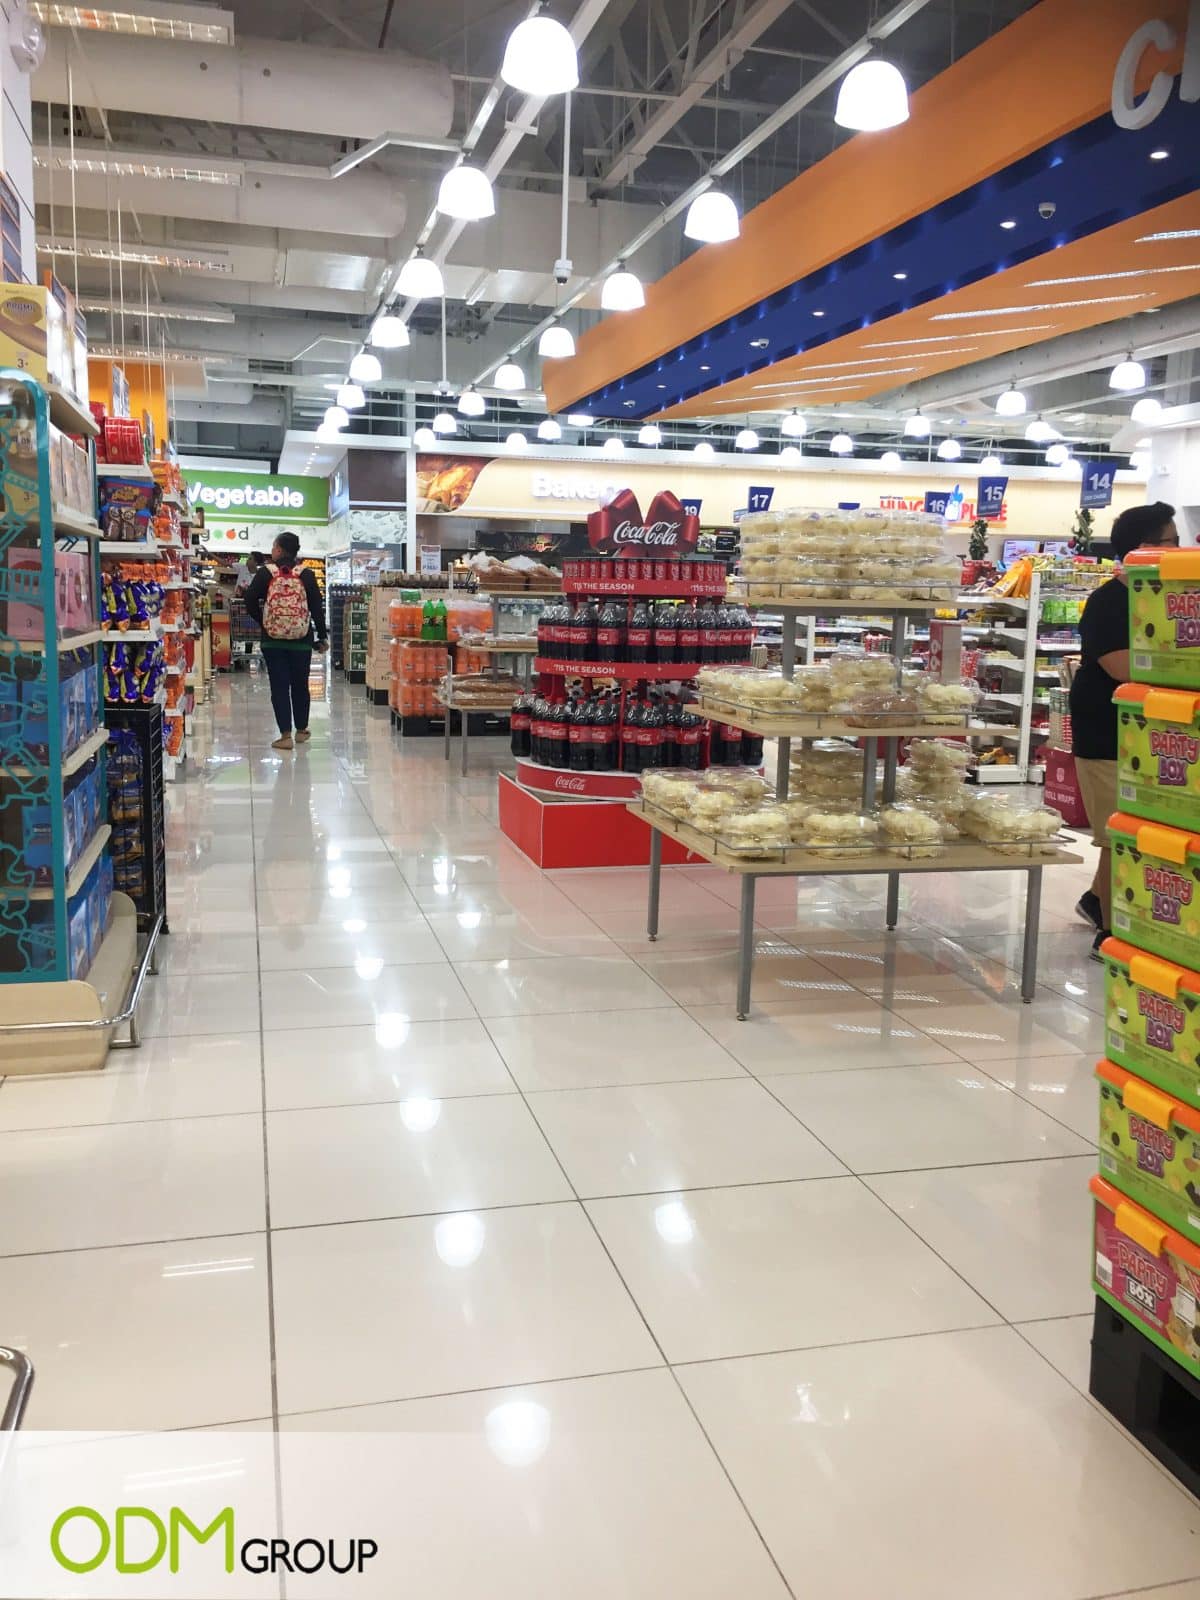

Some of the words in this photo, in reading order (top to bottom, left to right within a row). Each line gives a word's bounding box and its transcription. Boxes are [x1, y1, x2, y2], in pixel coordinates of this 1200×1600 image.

[984, 486, 1003, 501] 15
[1088, 472, 1111, 490] 14
[187, 482, 304, 509] Vegetable
[751, 494, 769, 508] 17
[929, 499, 946, 514] 16
[684, 505, 698, 516] 19
[599, 583, 635, 591] SEASON
[566, 664, 580, 673] THE
[581, 665, 616, 675] SEASON
[1150, 730, 1200, 764] PARTY
[1159, 756, 1187, 781] BOX
[1143, 864, 1193, 905] PARTY
[1152, 892, 1181, 920] BOX
[1137, 988, 1185, 1033] PARTY
[1145, 1020, 1174, 1048] BOX
[1128, 1113, 1176, 1161] PARTY
[1118, 1241, 1168, 1300] PARTY
[1129, 1280, 1154, 1308] BOX
